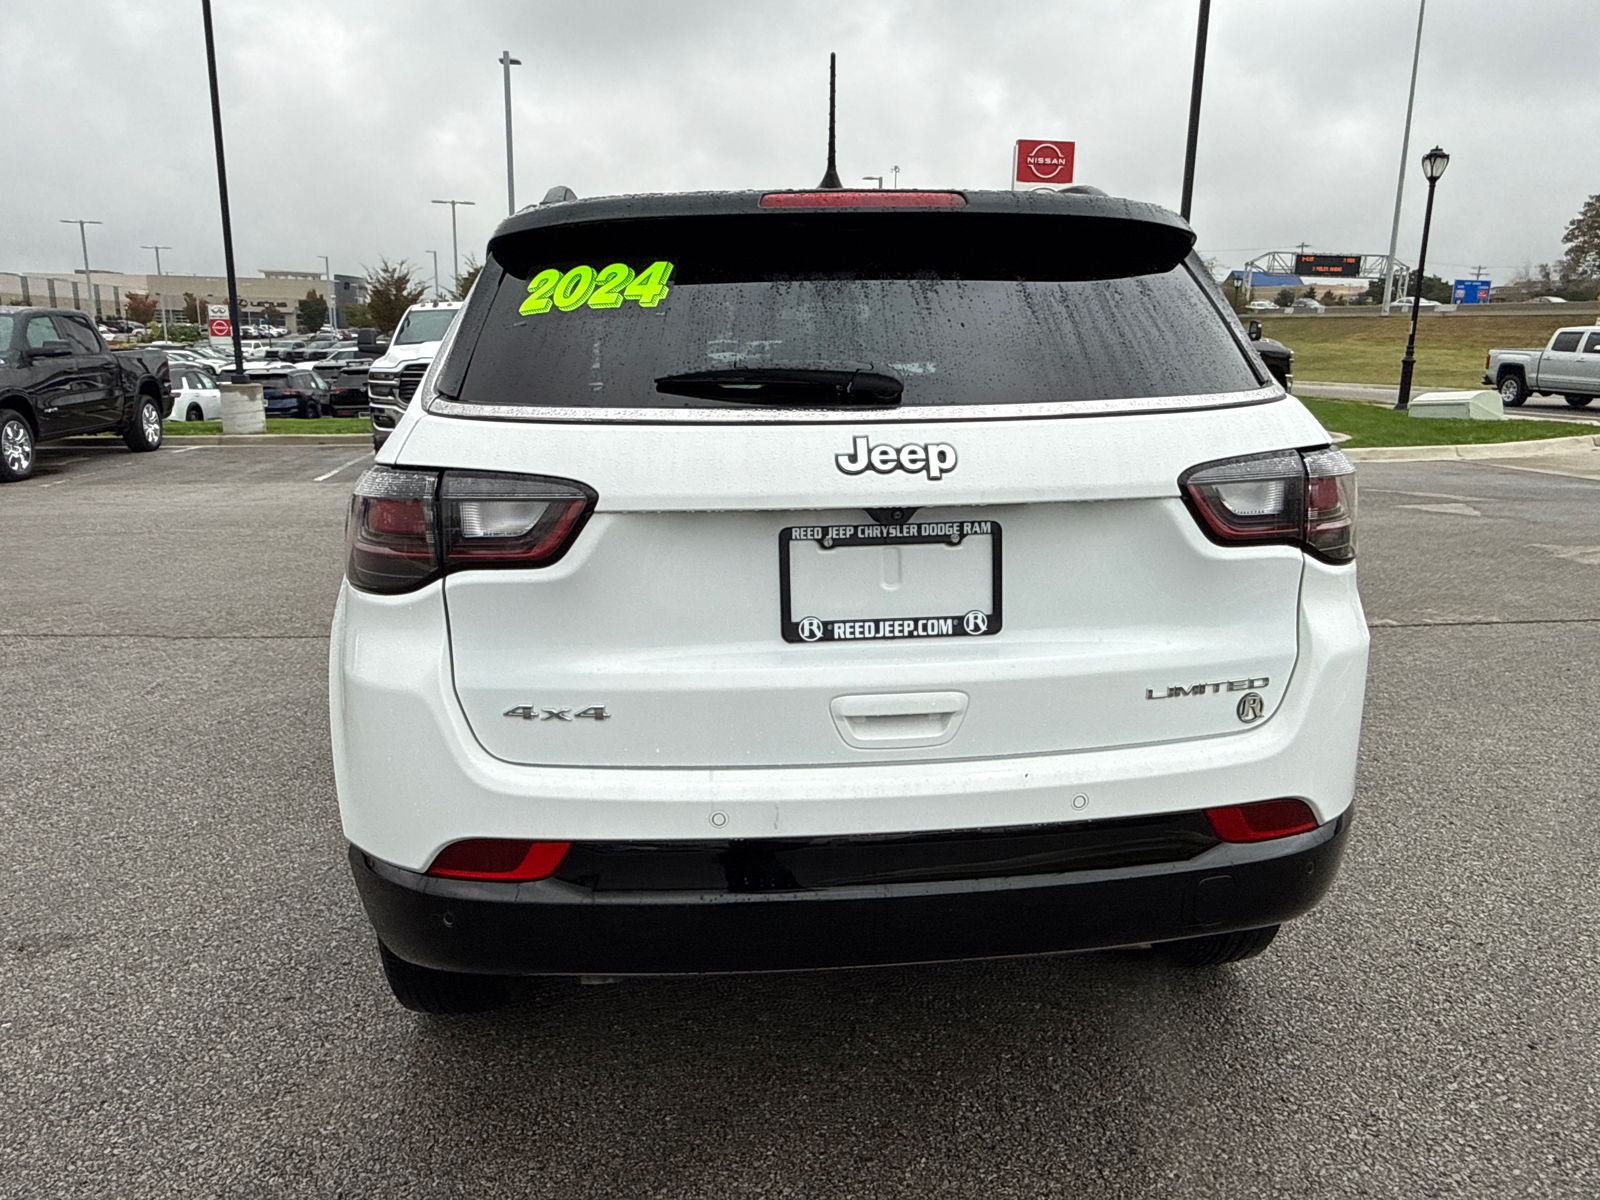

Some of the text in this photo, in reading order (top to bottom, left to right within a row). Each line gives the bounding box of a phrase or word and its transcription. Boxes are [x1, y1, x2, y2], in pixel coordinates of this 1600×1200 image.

[1027, 157, 1066, 165] NISSAN
[519, 261, 674, 316] 2024
[834, 435, 958, 481] Jeep
[791, 521, 991, 540] REED JEEP CHRYSLER DODGE RAM
[833, 619, 953, 639] REEDJEEP.COM
[1145, 676, 1270, 700] LIMITED
